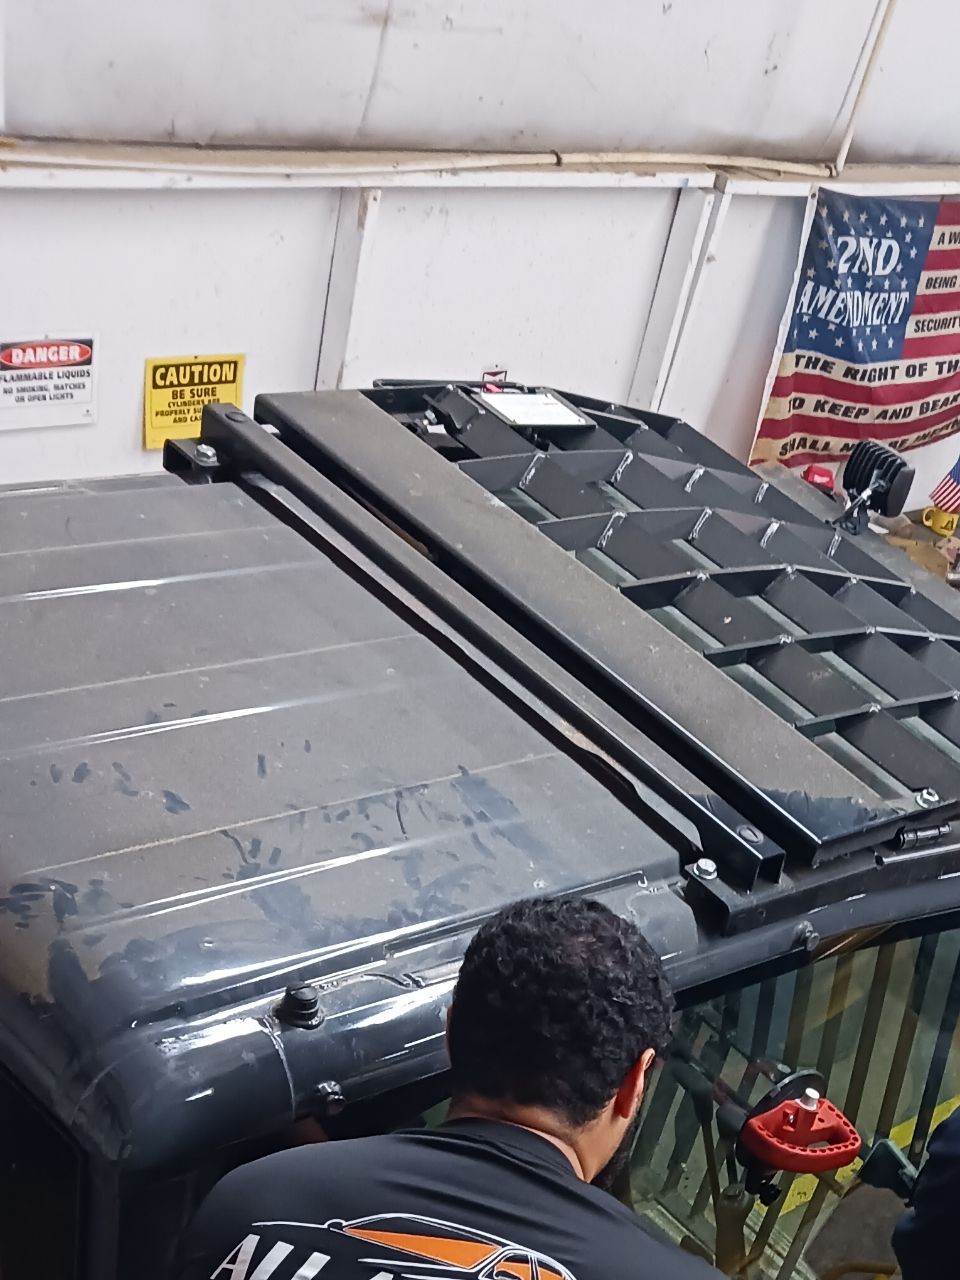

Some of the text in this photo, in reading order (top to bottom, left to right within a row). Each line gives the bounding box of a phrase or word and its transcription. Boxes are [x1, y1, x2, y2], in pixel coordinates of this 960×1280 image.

[938, 232, 945, 245] A
[837, 236, 900, 276] 2ND
[925, 274, 957, 289] BEING
[796, 280, 909, 328] AMENDMENT
[11, 345, 80, 363] DANGER
[57, 369, 90, 379] LIQUIDS
[155, 363, 234, 386] CAUTION
[795, 355, 835, 374] THE
[843, 366, 899, 383] RIGHT
[905, 363, 927, 378] OF
[53, 382, 86, 390] MATCHES
[172, 387, 217, 399] BE SURE
[155, 407, 190, 416] PROPERLY
[813, 399, 869, 420] KEEP
[874, 407, 913, 420] AND
[779, 437, 830, 456] SHALL
